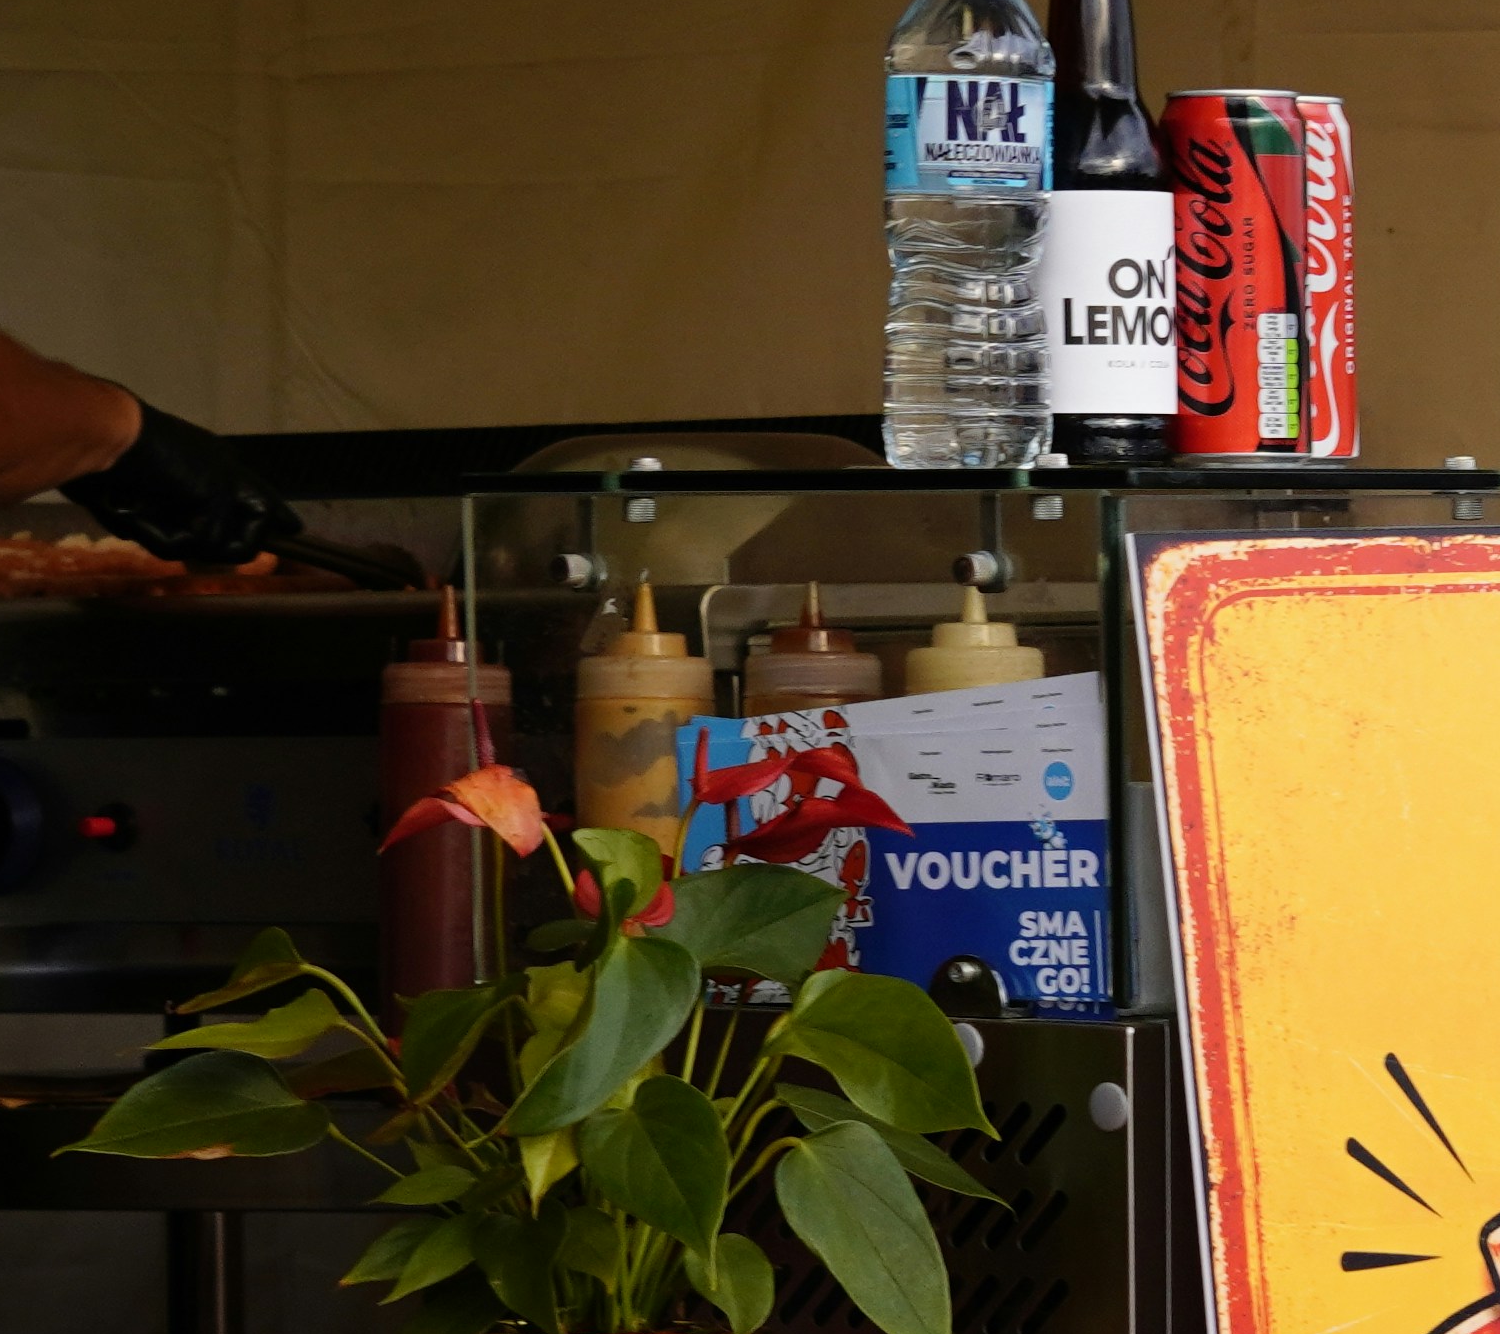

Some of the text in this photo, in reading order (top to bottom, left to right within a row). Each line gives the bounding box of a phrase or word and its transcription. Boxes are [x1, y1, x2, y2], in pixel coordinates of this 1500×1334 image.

[946, 79, 1027, 144] NAŁ
[1108, 258, 1167, 299] ON
[1241, 216, 1257, 332] ZERO SUGAR
[1342, 194, 1356, 375] ORIGINAL TASTE
[1063, 297, 1176, 347] LEMO
[885, 848, 1100, 891] VOUCHER
[1018, 909, 1088, 939] SMA
[1009, 938, 1090, 967] CZNE
[1035, 966, 1091, 995] GO!
